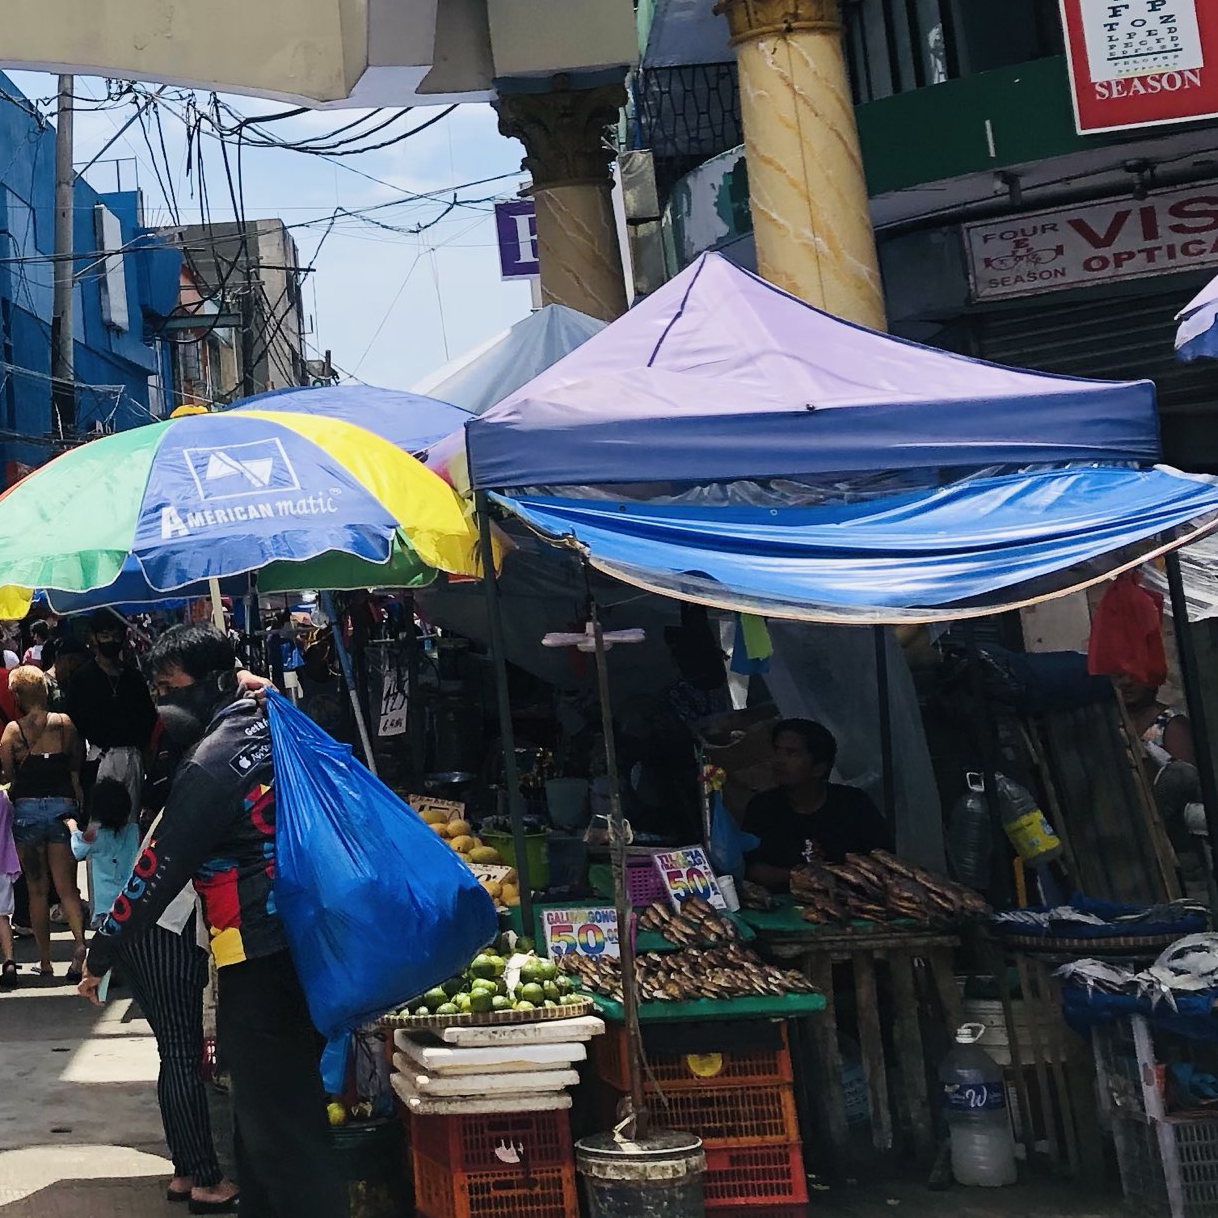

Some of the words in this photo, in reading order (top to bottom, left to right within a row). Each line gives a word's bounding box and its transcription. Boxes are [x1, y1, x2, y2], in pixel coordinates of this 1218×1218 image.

[1094, 69, 1202, 101] SEASON
[983, 222, 1059, 244] FOUR
[988, 267, 1067, 289] SEASON
[160, 501, 273, 539] AMERICAN
[275, 491, 338, 520] matic
[667, 868, 711, 902] 50
